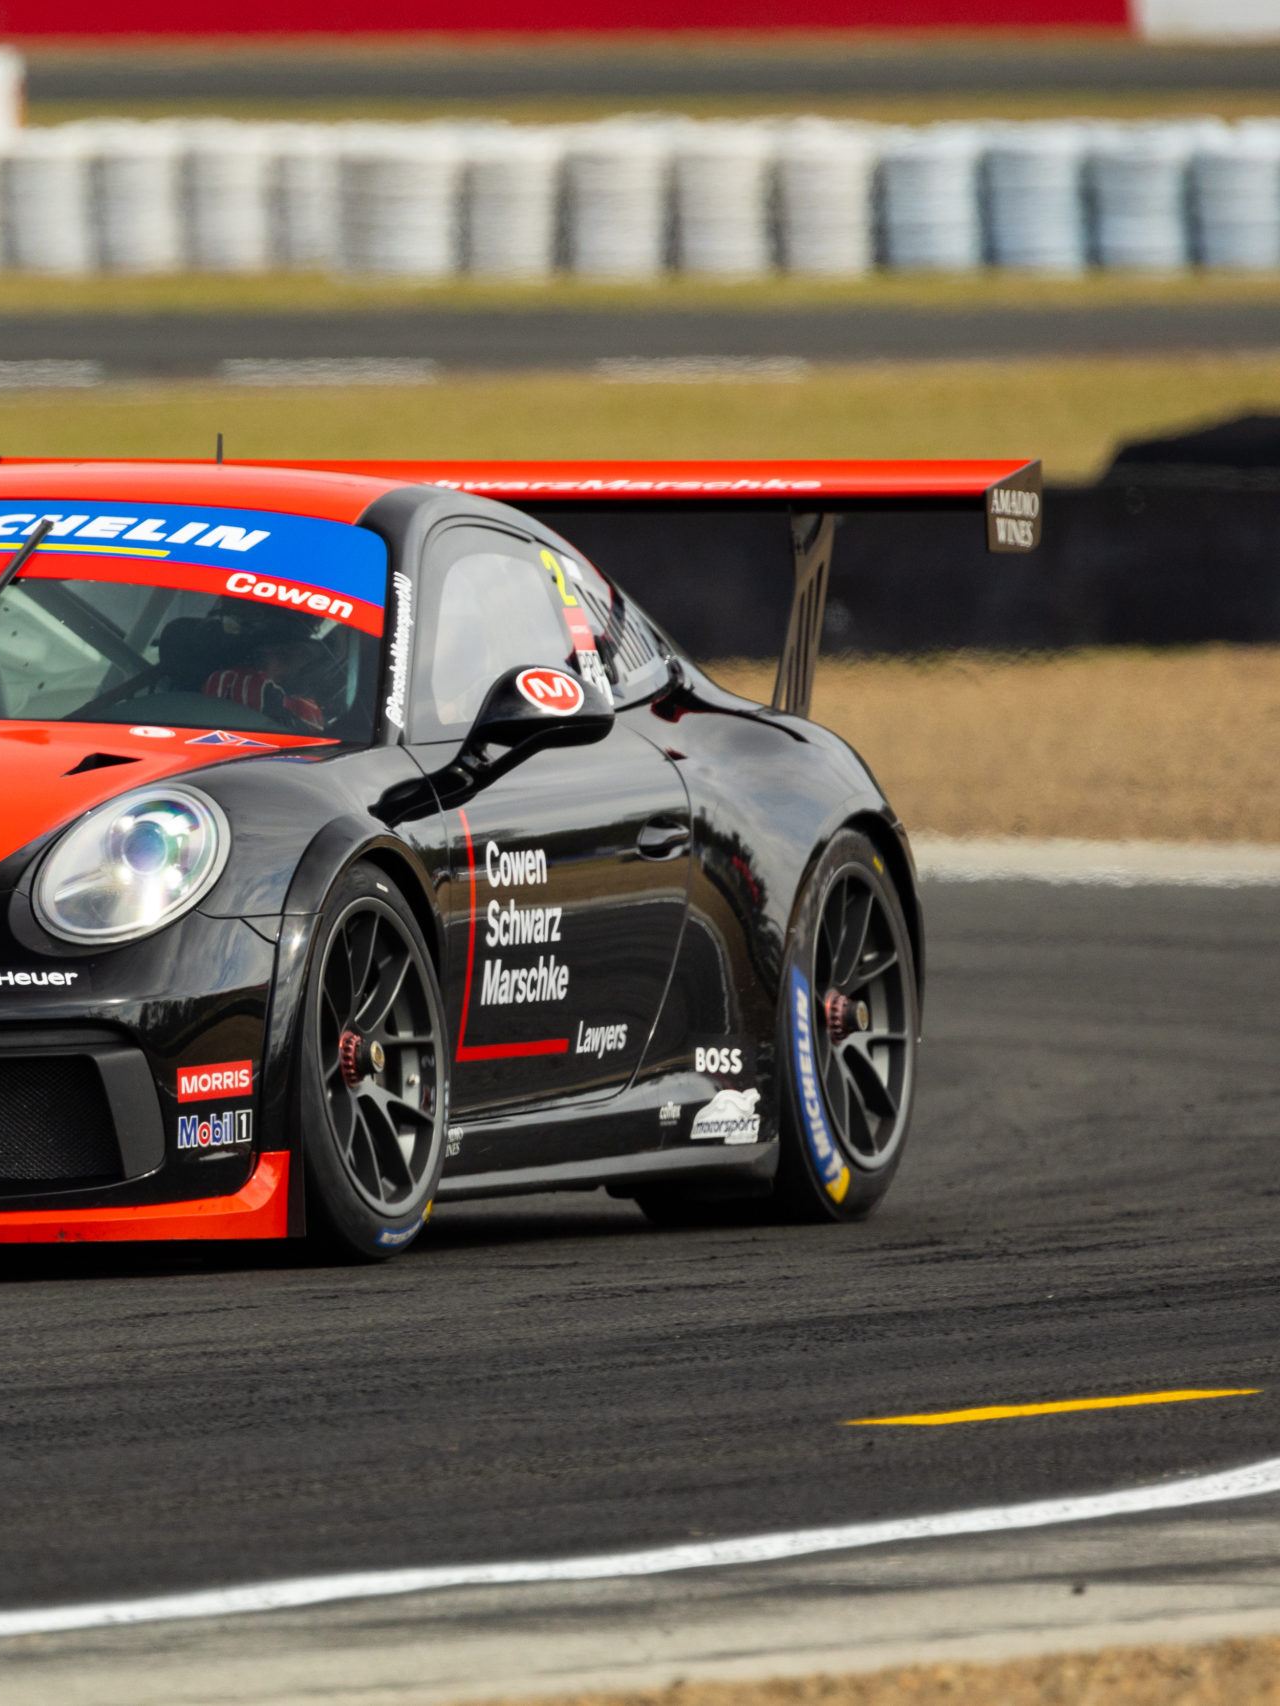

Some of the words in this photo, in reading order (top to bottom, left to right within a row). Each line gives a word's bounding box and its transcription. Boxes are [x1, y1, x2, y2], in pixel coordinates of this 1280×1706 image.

[995, 517, 1034, 548] WINES
[225, 572, 354, 619] Cowen
[540, 549, 578, 606] 2
[527, 676, 575, 699] M
[486, 840, 548, 888] Cowen
[485, 898, 562, 947] Schwarz
[480, 954, 569, 1006] Marschke
[576, 1020, 629, 1060] Lawyers
[695, 1046, 743, 1075] BOSS
[181, 1069, 250, 1094] MORRIS
[796, 986, 833, 1159] MICHELIN
[177, 1111, 233, 1149] Mobil
